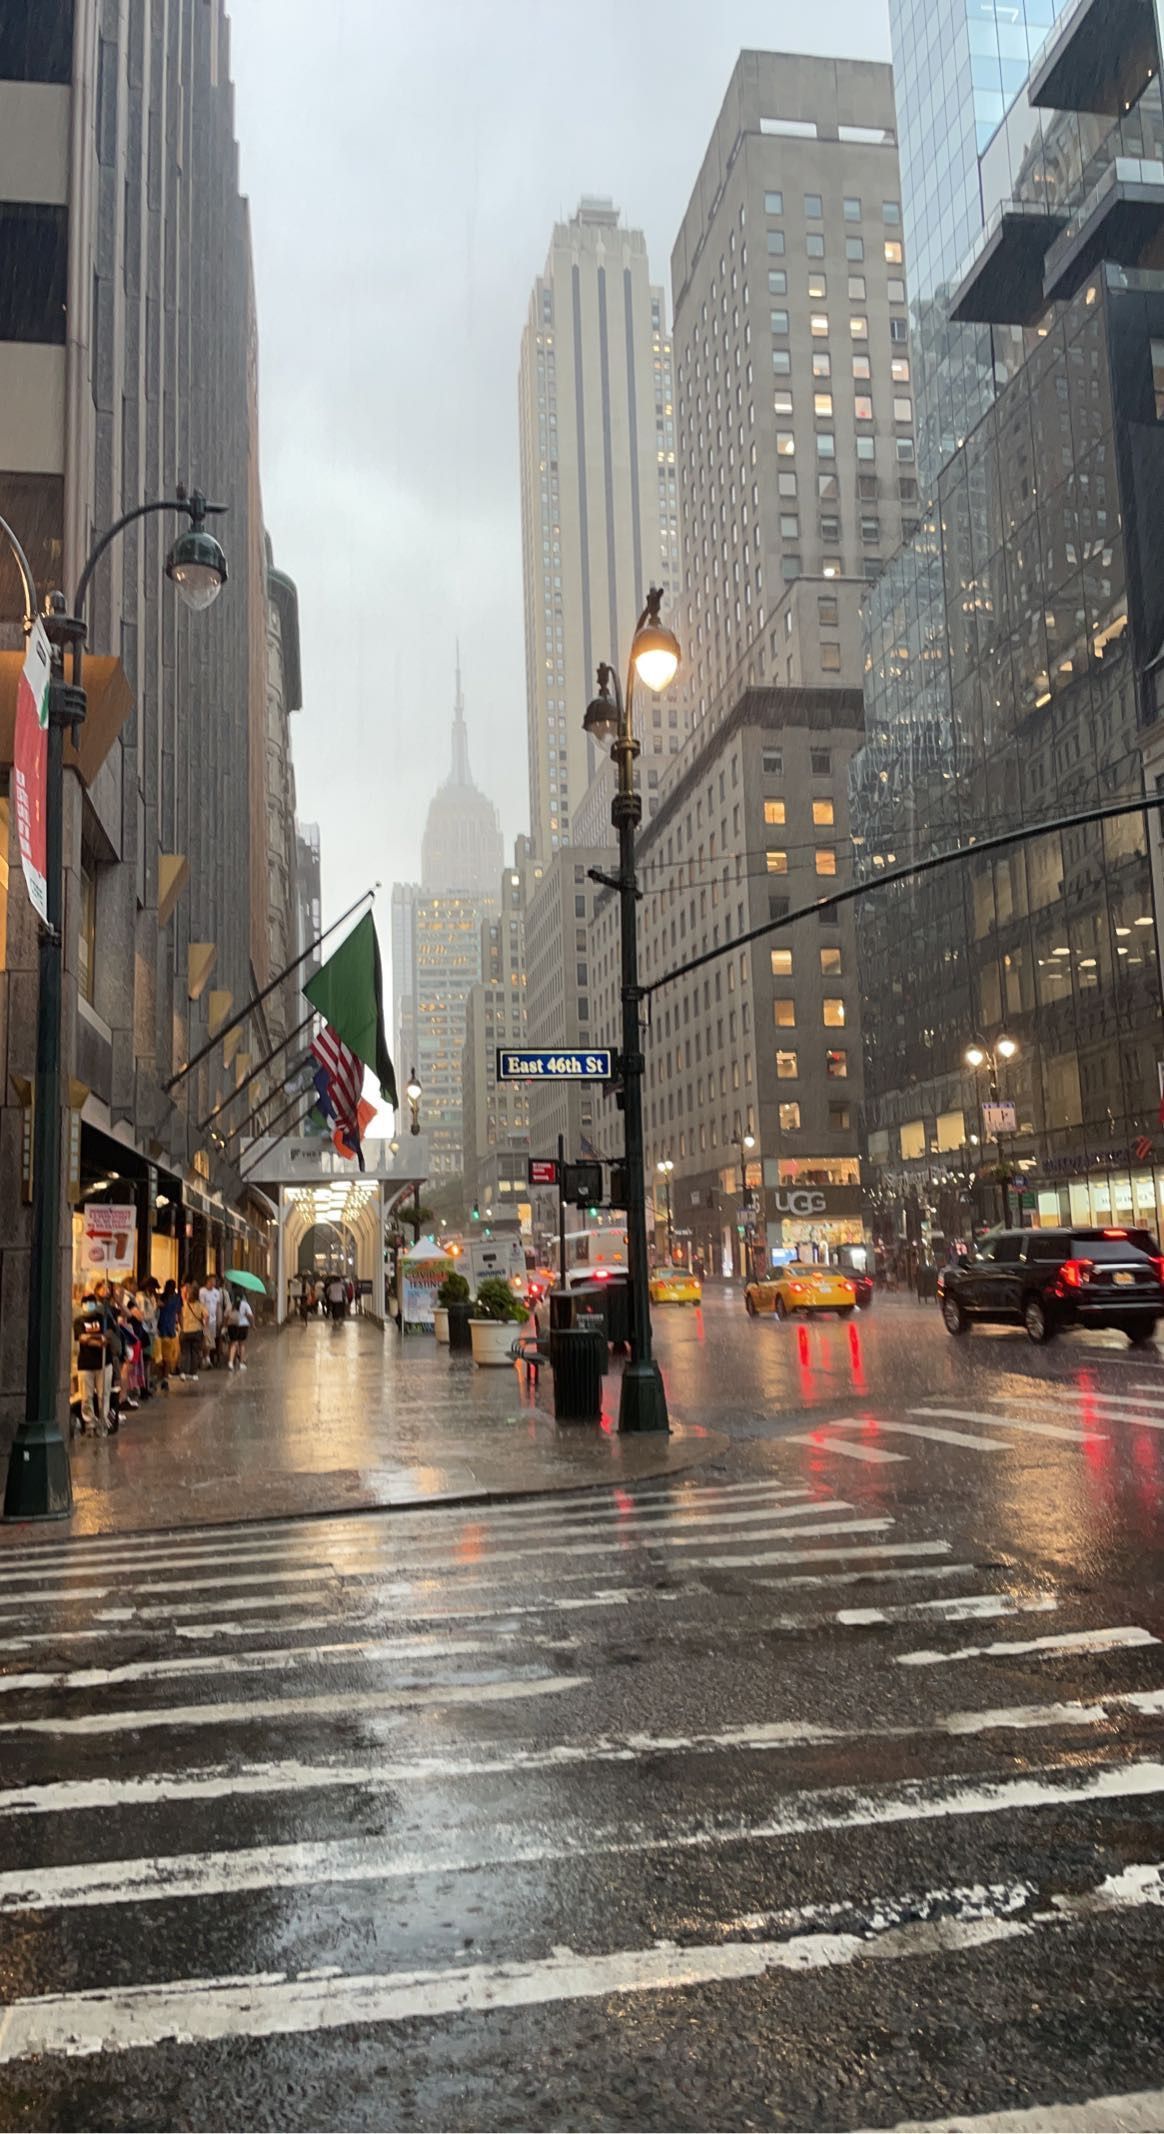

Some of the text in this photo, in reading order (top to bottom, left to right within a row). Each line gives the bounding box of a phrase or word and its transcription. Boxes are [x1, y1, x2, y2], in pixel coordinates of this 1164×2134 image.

[508, 1056, 604, 1074] East 46th St
[774, 1190, 827, 1216] UGG
